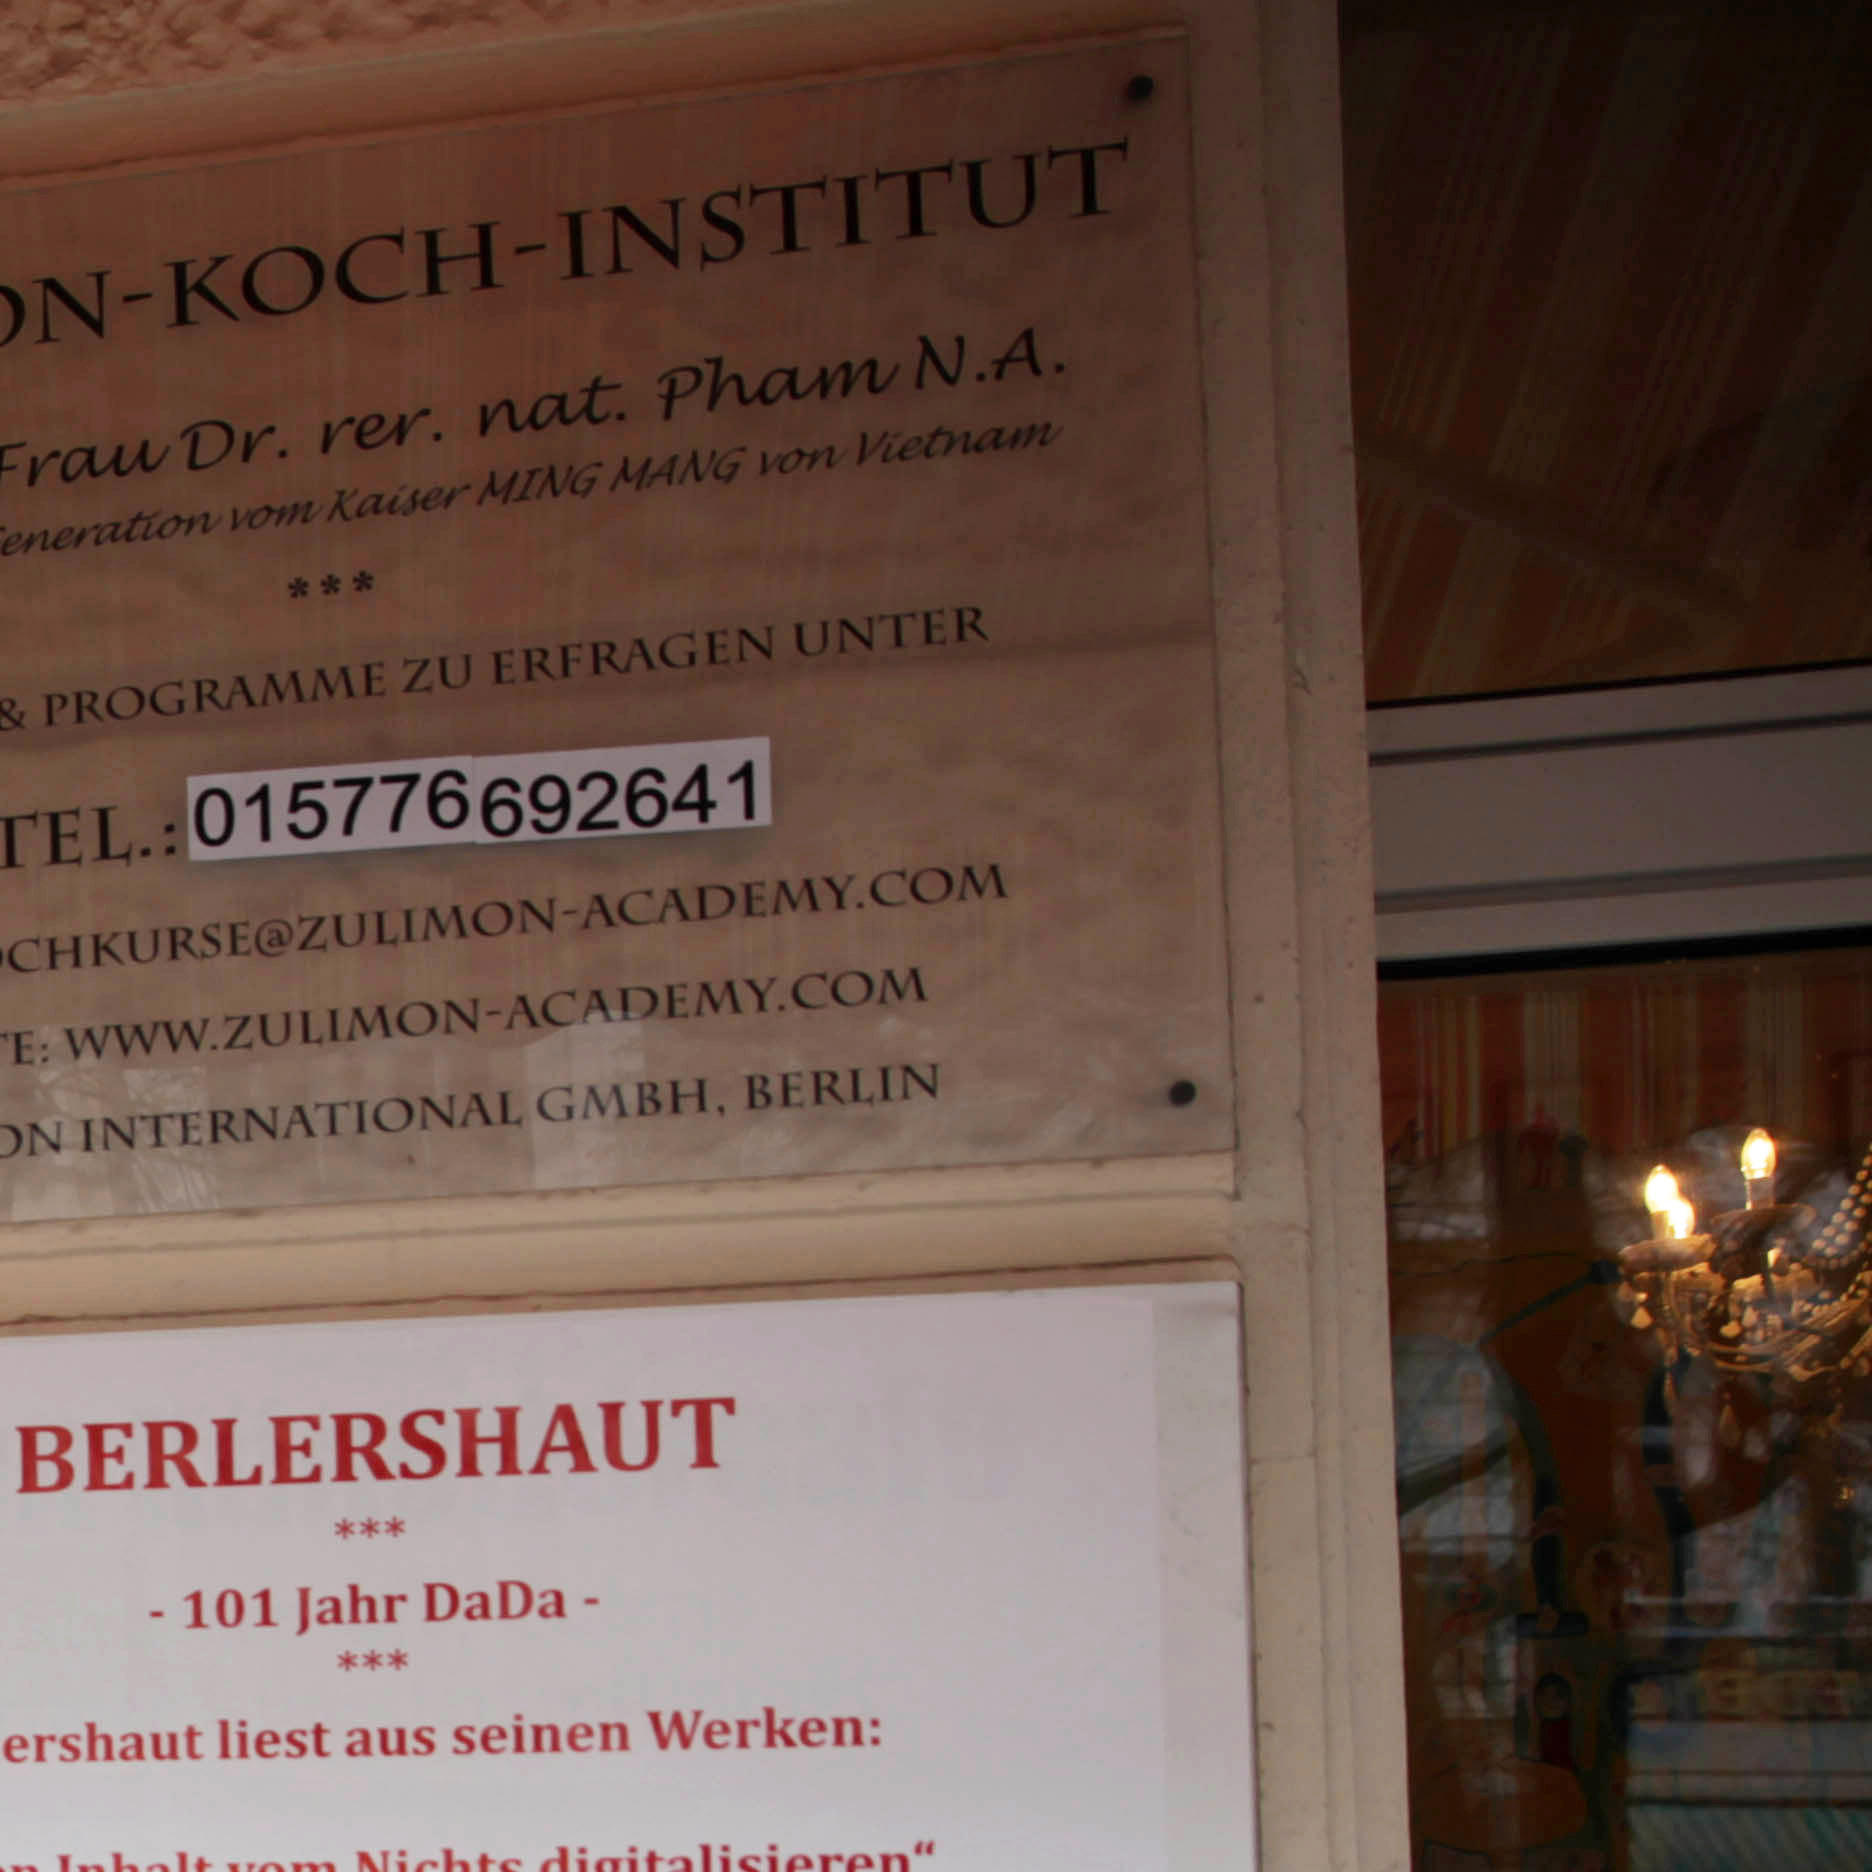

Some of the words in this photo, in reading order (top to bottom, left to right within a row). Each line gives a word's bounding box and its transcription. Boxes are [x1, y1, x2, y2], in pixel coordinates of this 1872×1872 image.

[178, 417, 290, 473] Dr.
[319, 406, 443, 456] rer.
[477, 374, 626, 438] nat.
[656, 355, 901, 422] Pham
[912, 325, 1067, 391] N.A.
[228, 497, 325, 532] vom
[474, 460, 604, 507] MING
[608, 444, 747, 492] MANG
[758, 442, 848, 477] von
[855, 420, 1065, 467] Vietnam
[42, 660, 385, 728] PROGRAMME
[401, 653, 471, 693] ZU
[491, 624, 774, 685] ERFRAGEN
[793, 605, 989, 657] UNTER
[193, 758, 755, 848] 015776692641
[62, 965, 927, 1061] WWW.ZULIMON-ACADEMY.COM
[78, 1089, 522, 1153] INTERNATIONAL
[535, 1077, 725, 1123] GMBH,
[745, 1061, 938, 1110] BERLIN
[15, 1396, 735, 1494] BERLERSHAUT
[183, 1587, 277, 1630] 101
[295, 1582, 408, 1636] Jahr
[423, 1579, 566, 1622] DaDa
[217, 1718, 331, 1760] liest
[344, 1724, 436, 1758] aus
[451, 1713, 631, 1755] seinen
[646, 1705, 881, 1751] Werken:
